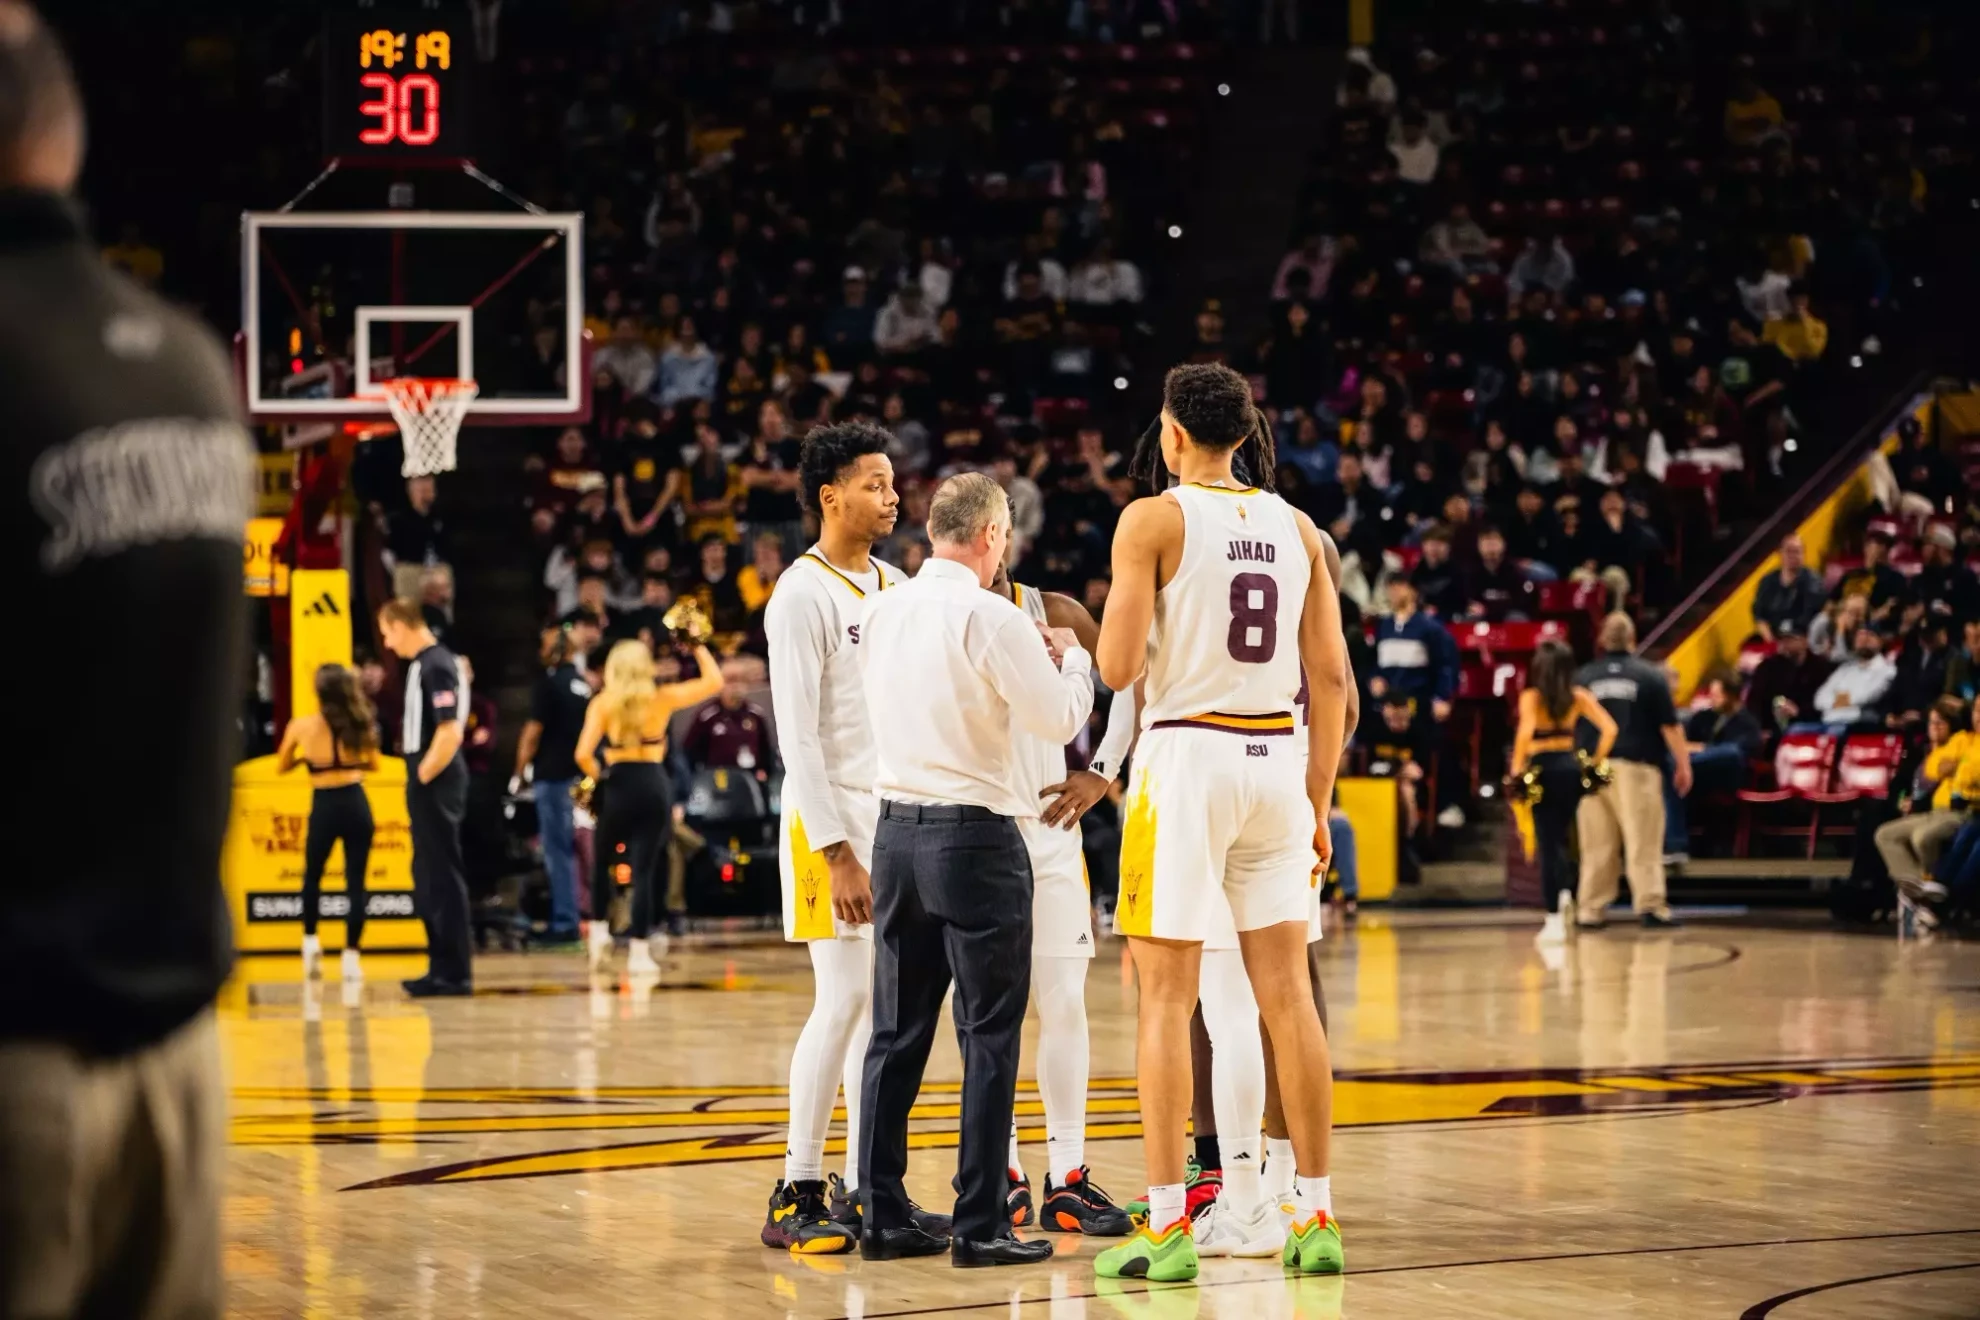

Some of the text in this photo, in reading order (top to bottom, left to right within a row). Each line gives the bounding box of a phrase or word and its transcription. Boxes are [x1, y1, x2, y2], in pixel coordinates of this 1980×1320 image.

[359, 73, 440, 145] 30
[1227, 540, 1276, 563] JIHAD
[1227, 572, 1278, 664] 8
[847, 624, 860, 644] S
[1246, 744, 1268, 757] ASU
